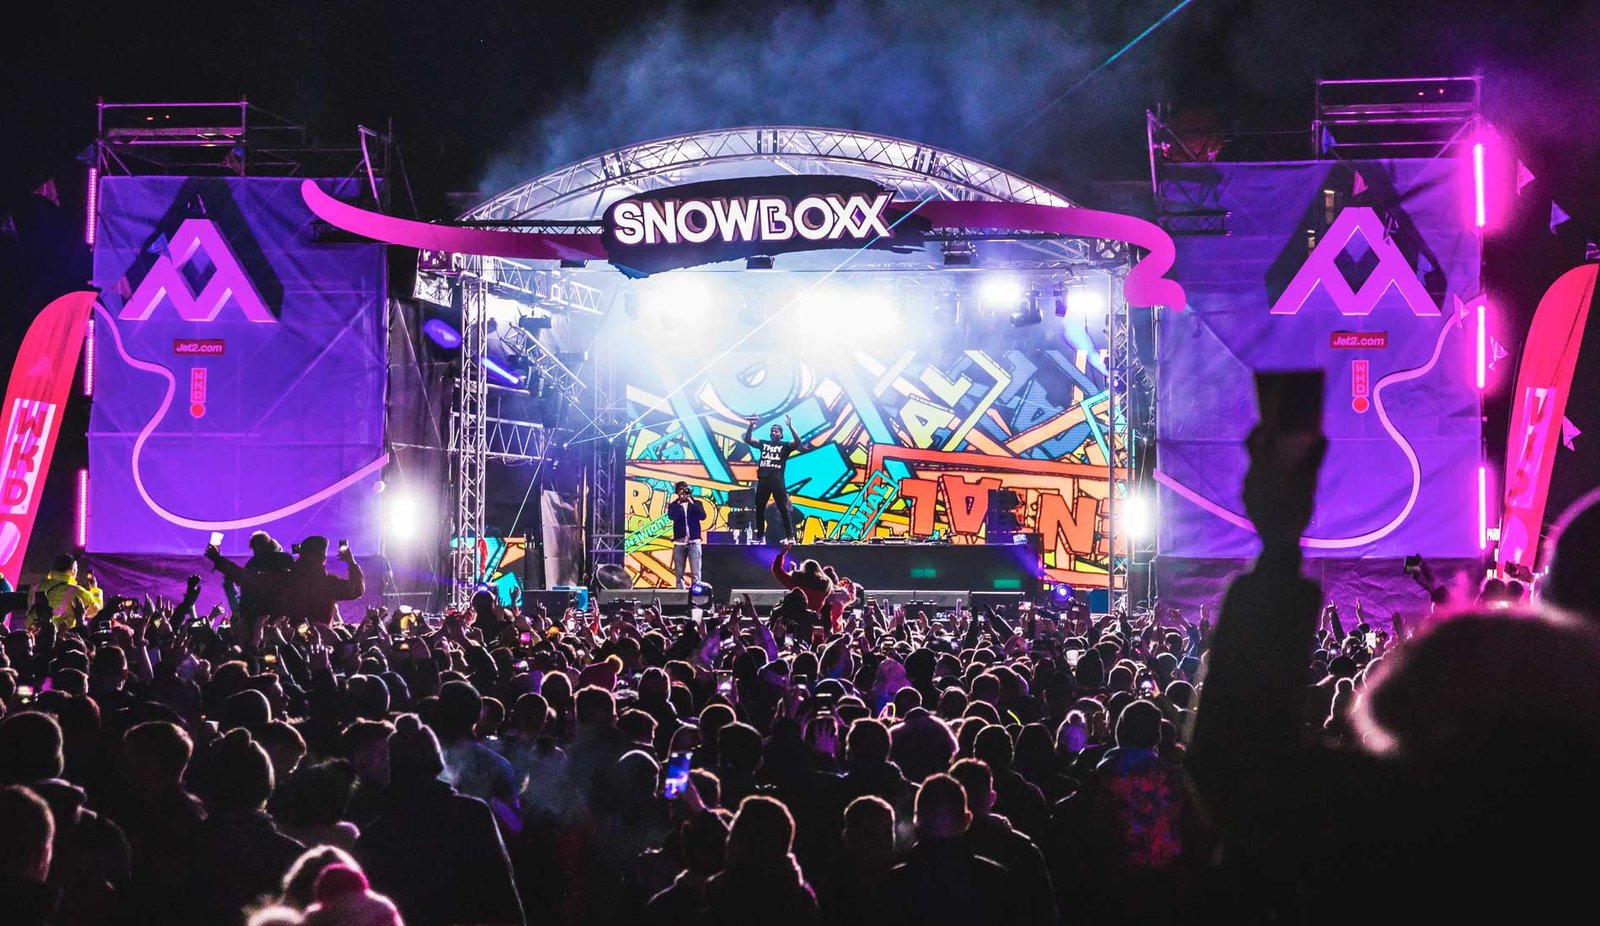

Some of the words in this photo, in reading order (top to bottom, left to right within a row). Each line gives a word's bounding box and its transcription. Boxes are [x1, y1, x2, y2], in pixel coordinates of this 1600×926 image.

[613, 193, 894, 245] SNOWBOXX
[1333, 335, 1386, 346] Jet2.com
[176, 342, 223, 353] Jet2.com
[762, 443, 783, 453] THEY
[2, 406, 48, 507] WKD
[761, 451, 781, 460] CALL
